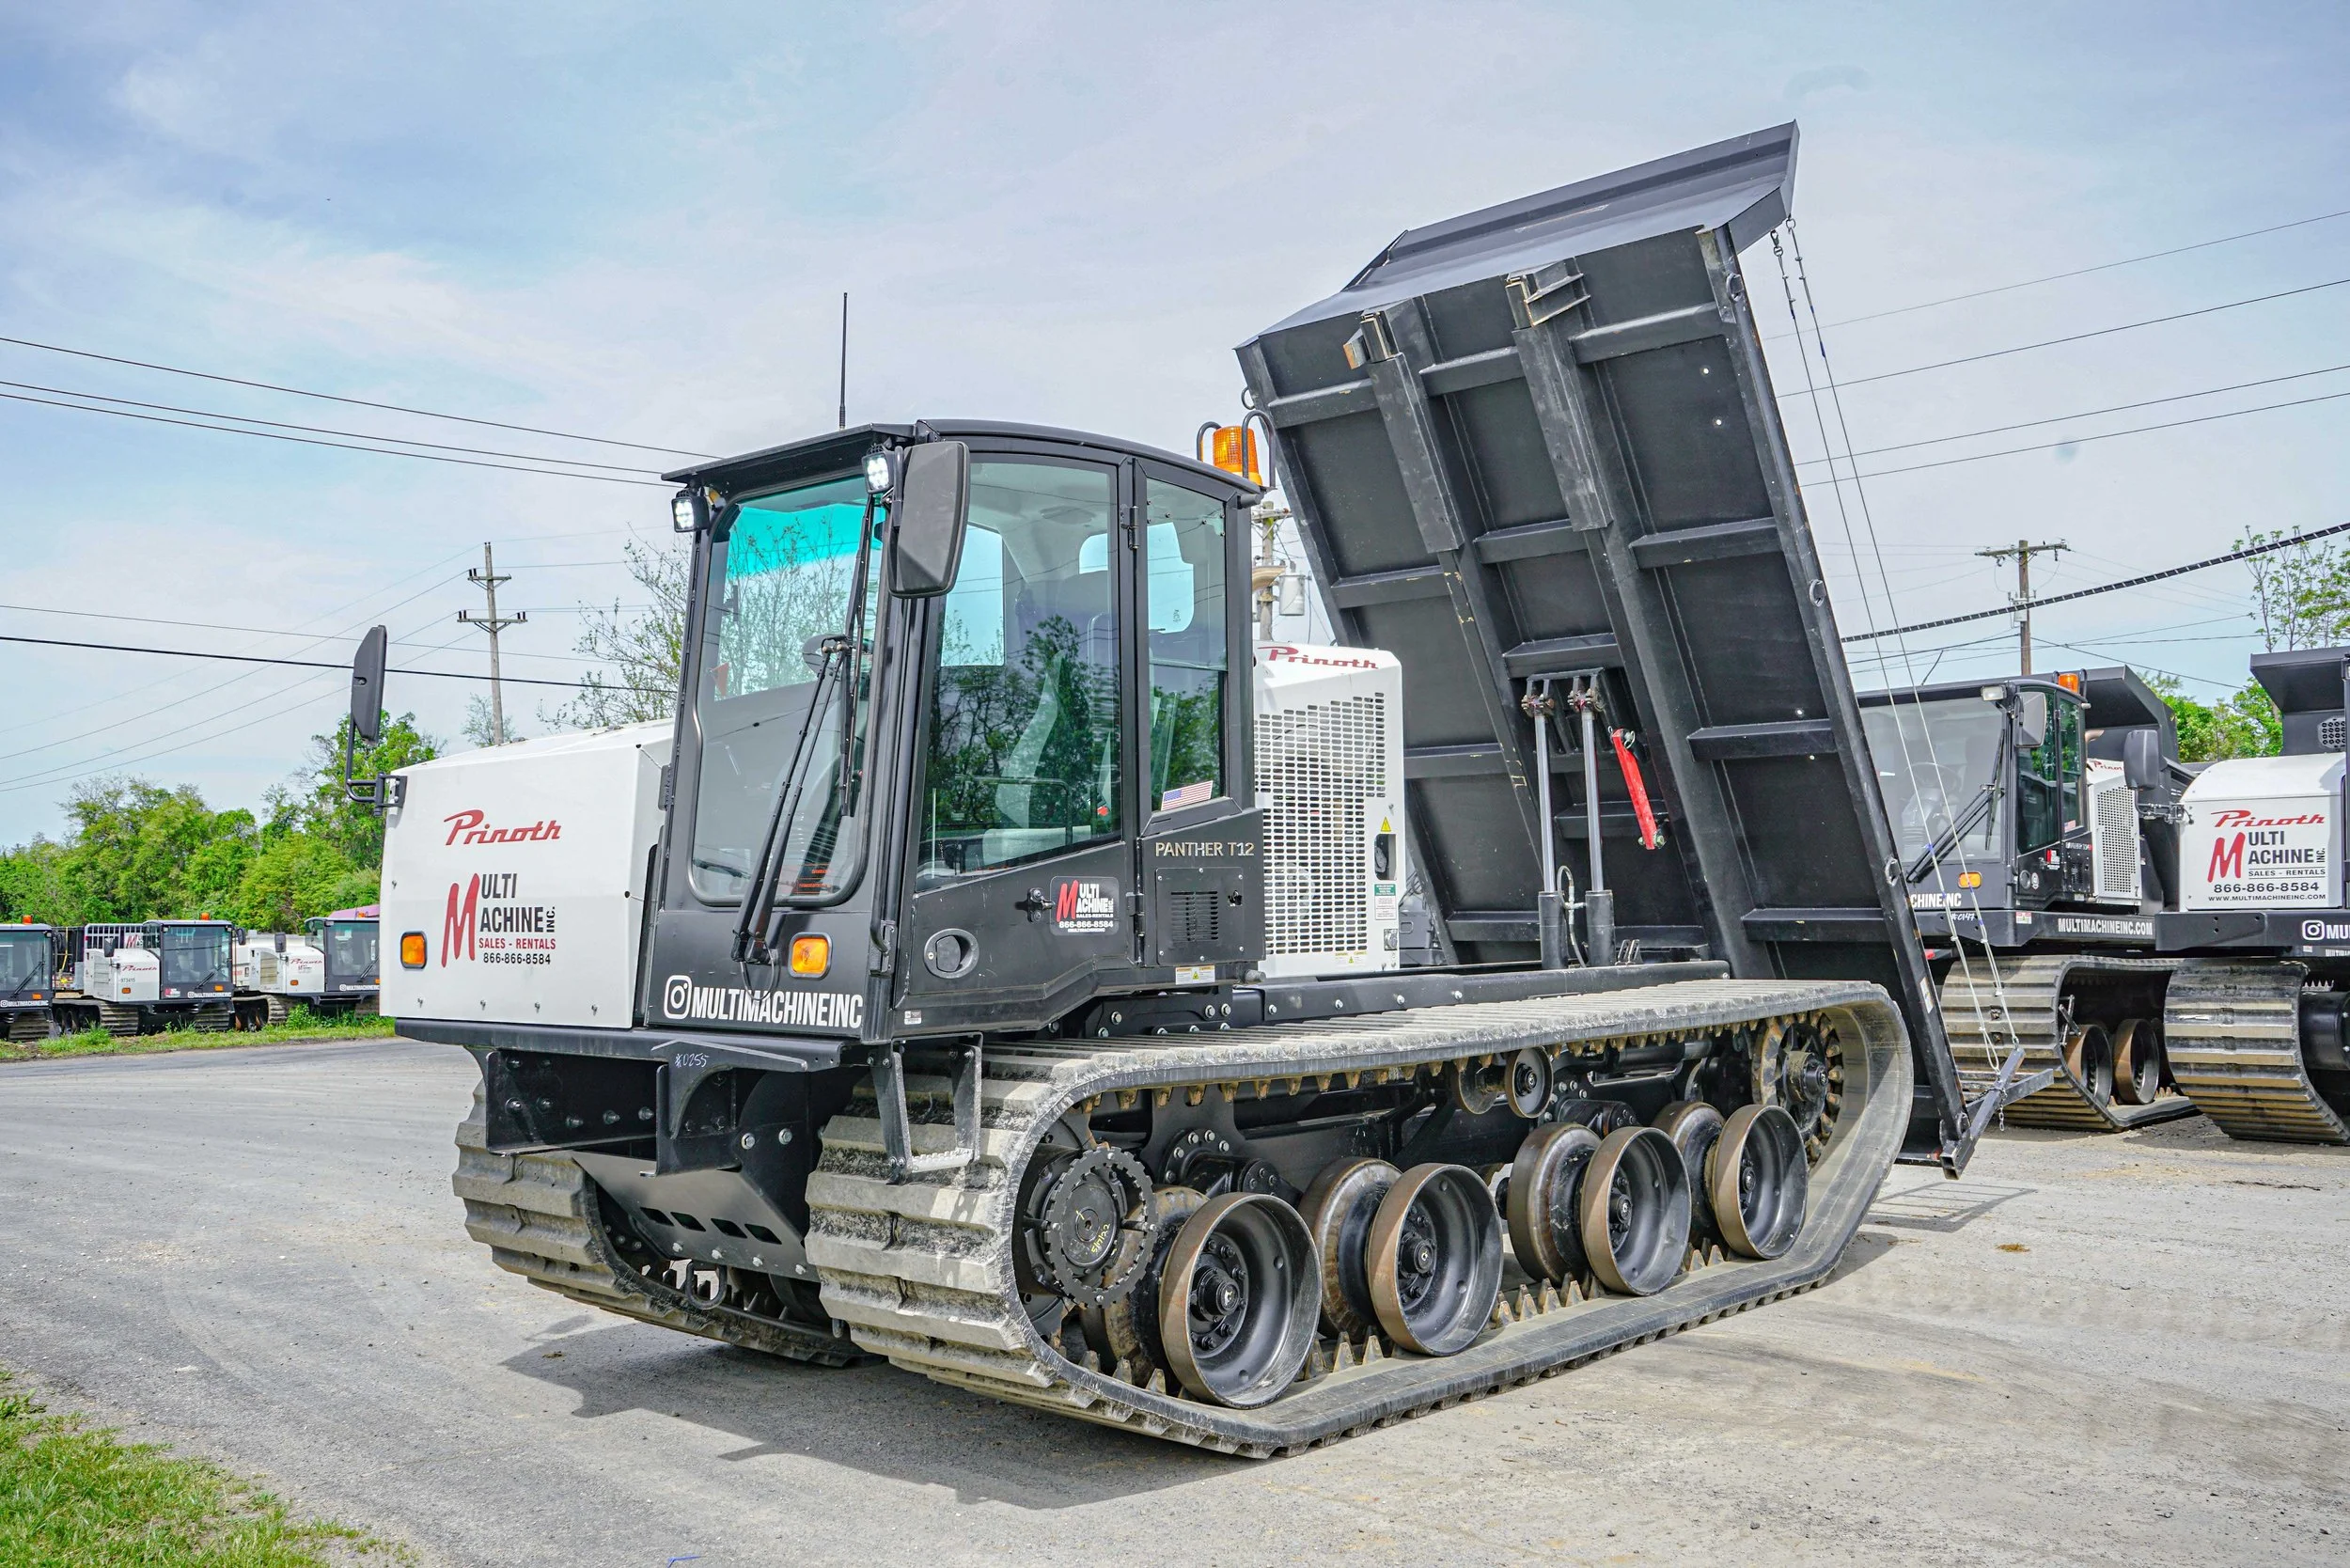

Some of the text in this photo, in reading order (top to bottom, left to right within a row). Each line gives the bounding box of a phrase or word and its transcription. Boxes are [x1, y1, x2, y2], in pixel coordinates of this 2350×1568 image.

[1257, 646, 1379, 669] Prinoth
[2210, 809, 2326, 828] Prinoth
[443, 809, 562, 846] Prinoth
[1155, 842, 1255, 857] PANTHER T12
[2214, 882, 2320, 893] 866-866-8584
[1058, 920, 1114, 929] 866-866-8584
[2058, 917, 2154, 935] MULTIMACHINEINC.COM
[2326, 924, 2350, 939] MU
[478, 937, 506, 949] SALES
[515, 938, 556, 950] RENTALS
[483, 952, 552, 965] 866-866-8584
[691, 986, 864, 1029] MULTIMACHINEINC
